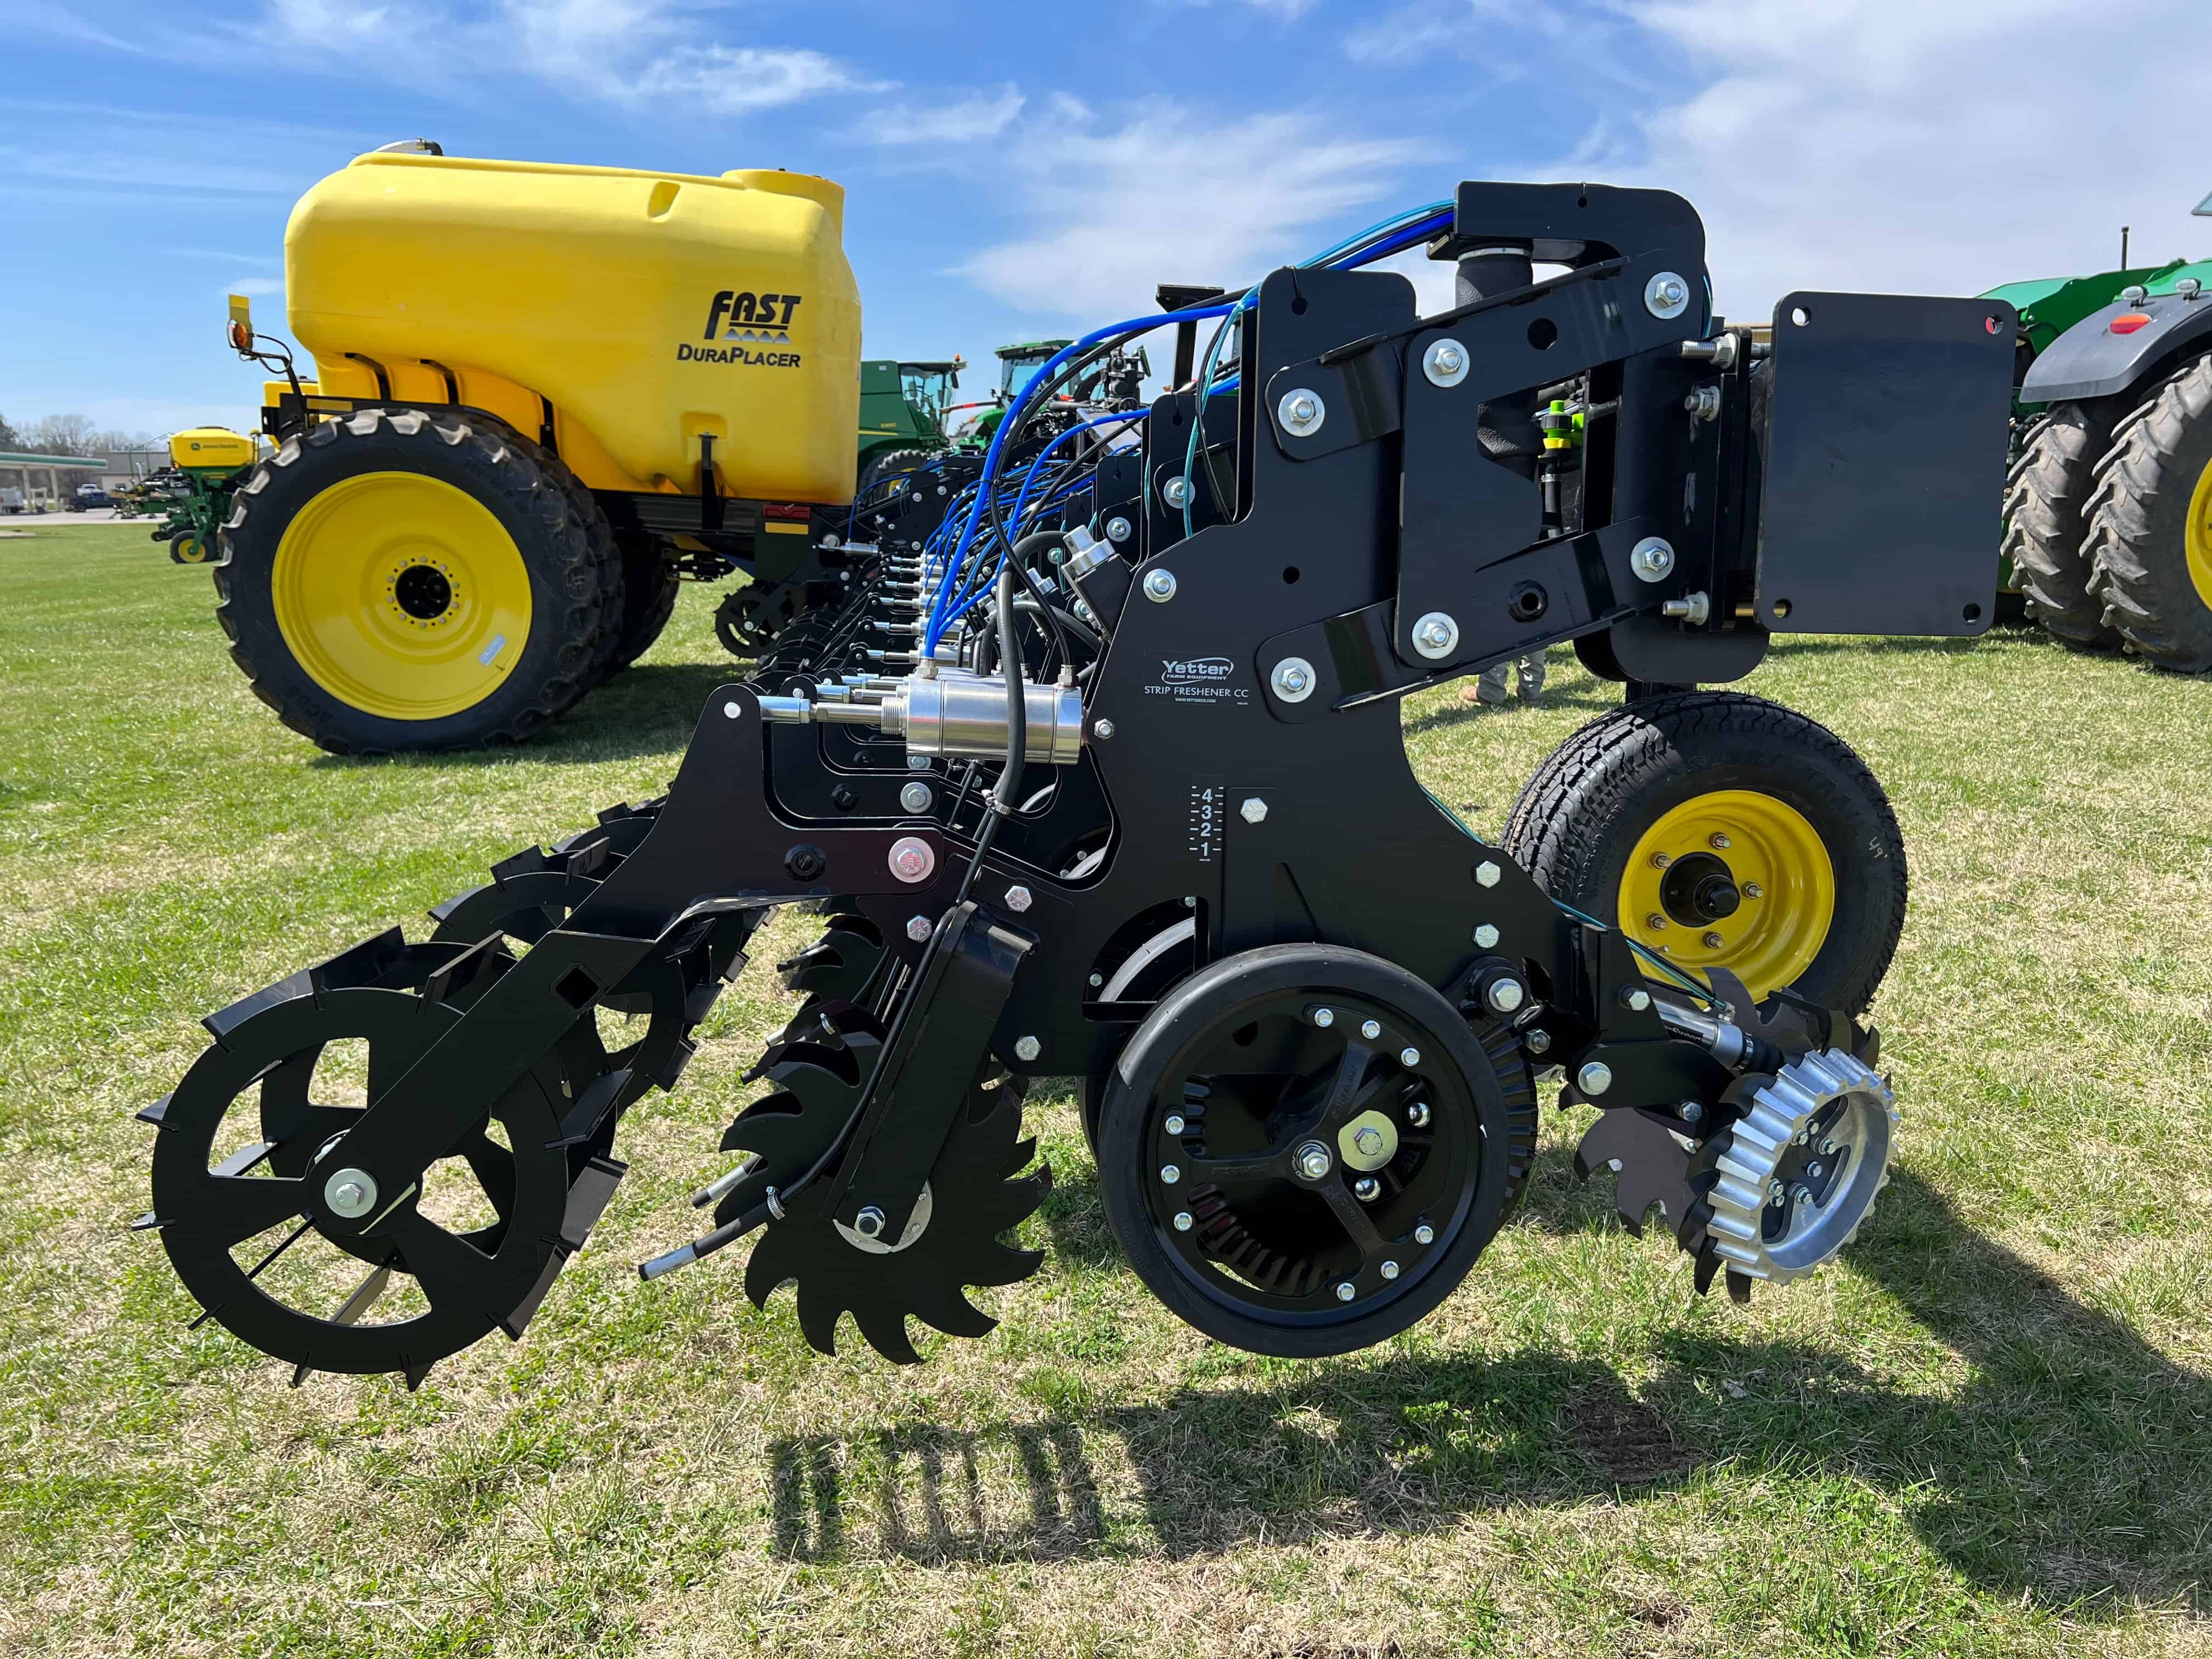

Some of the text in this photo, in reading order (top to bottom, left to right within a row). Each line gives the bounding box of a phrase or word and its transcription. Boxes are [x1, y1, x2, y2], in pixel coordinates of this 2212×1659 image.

[704, 291, 802, 340] FAST
[1162, 661, 1229, 675] Yetter
[1144, 686, 1249, 697] STRIP FRESHENER CC
[1201, 788, 1212, 803] 4
[1201, 804, 1212, 820] 3
[1200, 822, 1211, 837] 2
[1200, 842, 1208, 856] 1
